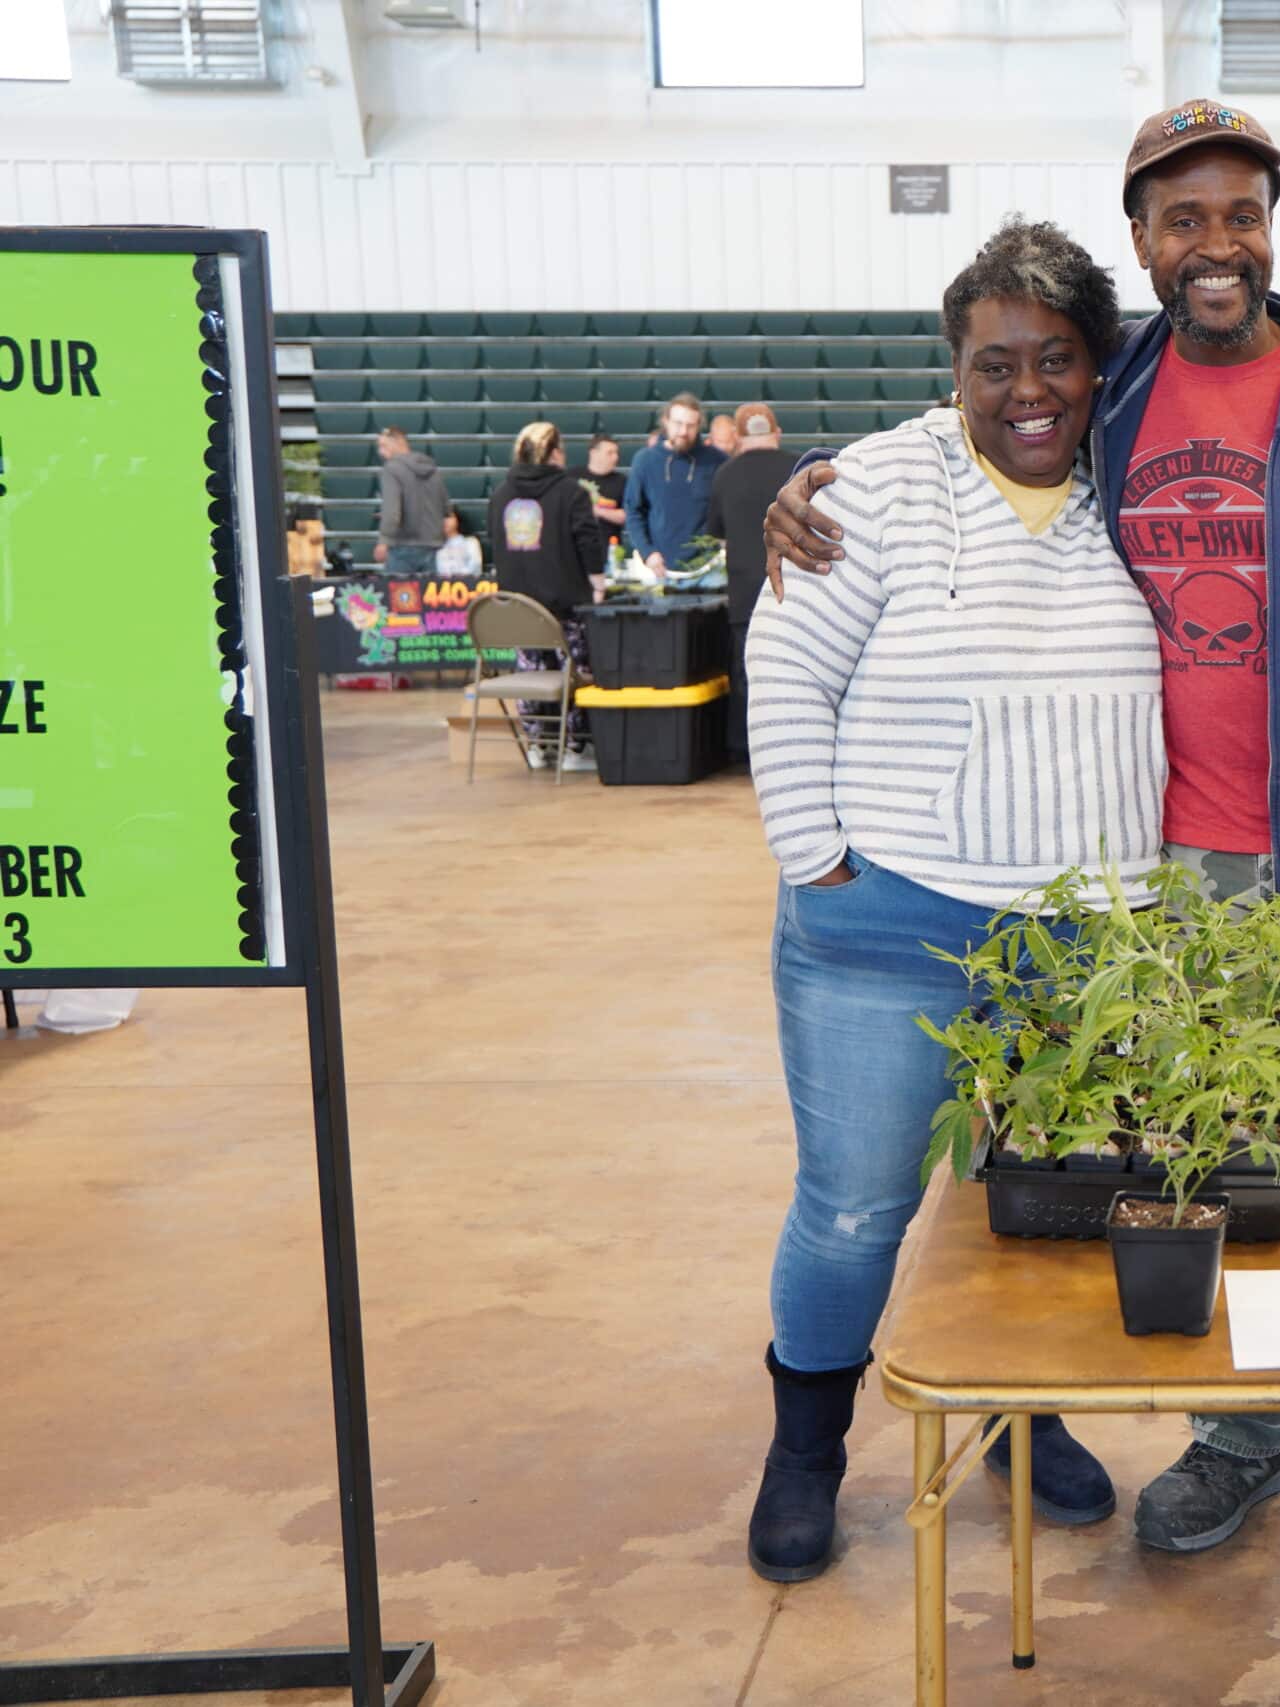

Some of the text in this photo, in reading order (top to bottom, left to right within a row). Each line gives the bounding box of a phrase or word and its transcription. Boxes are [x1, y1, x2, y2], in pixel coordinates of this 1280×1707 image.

[1162, 107, 1247, 127] CAMP MORE
[1163, 114, 1247, 137] WORRY LESS
[1123, 453, 1259, 504] LEGEND LIVES
[4, 912, 33, 964] 3
